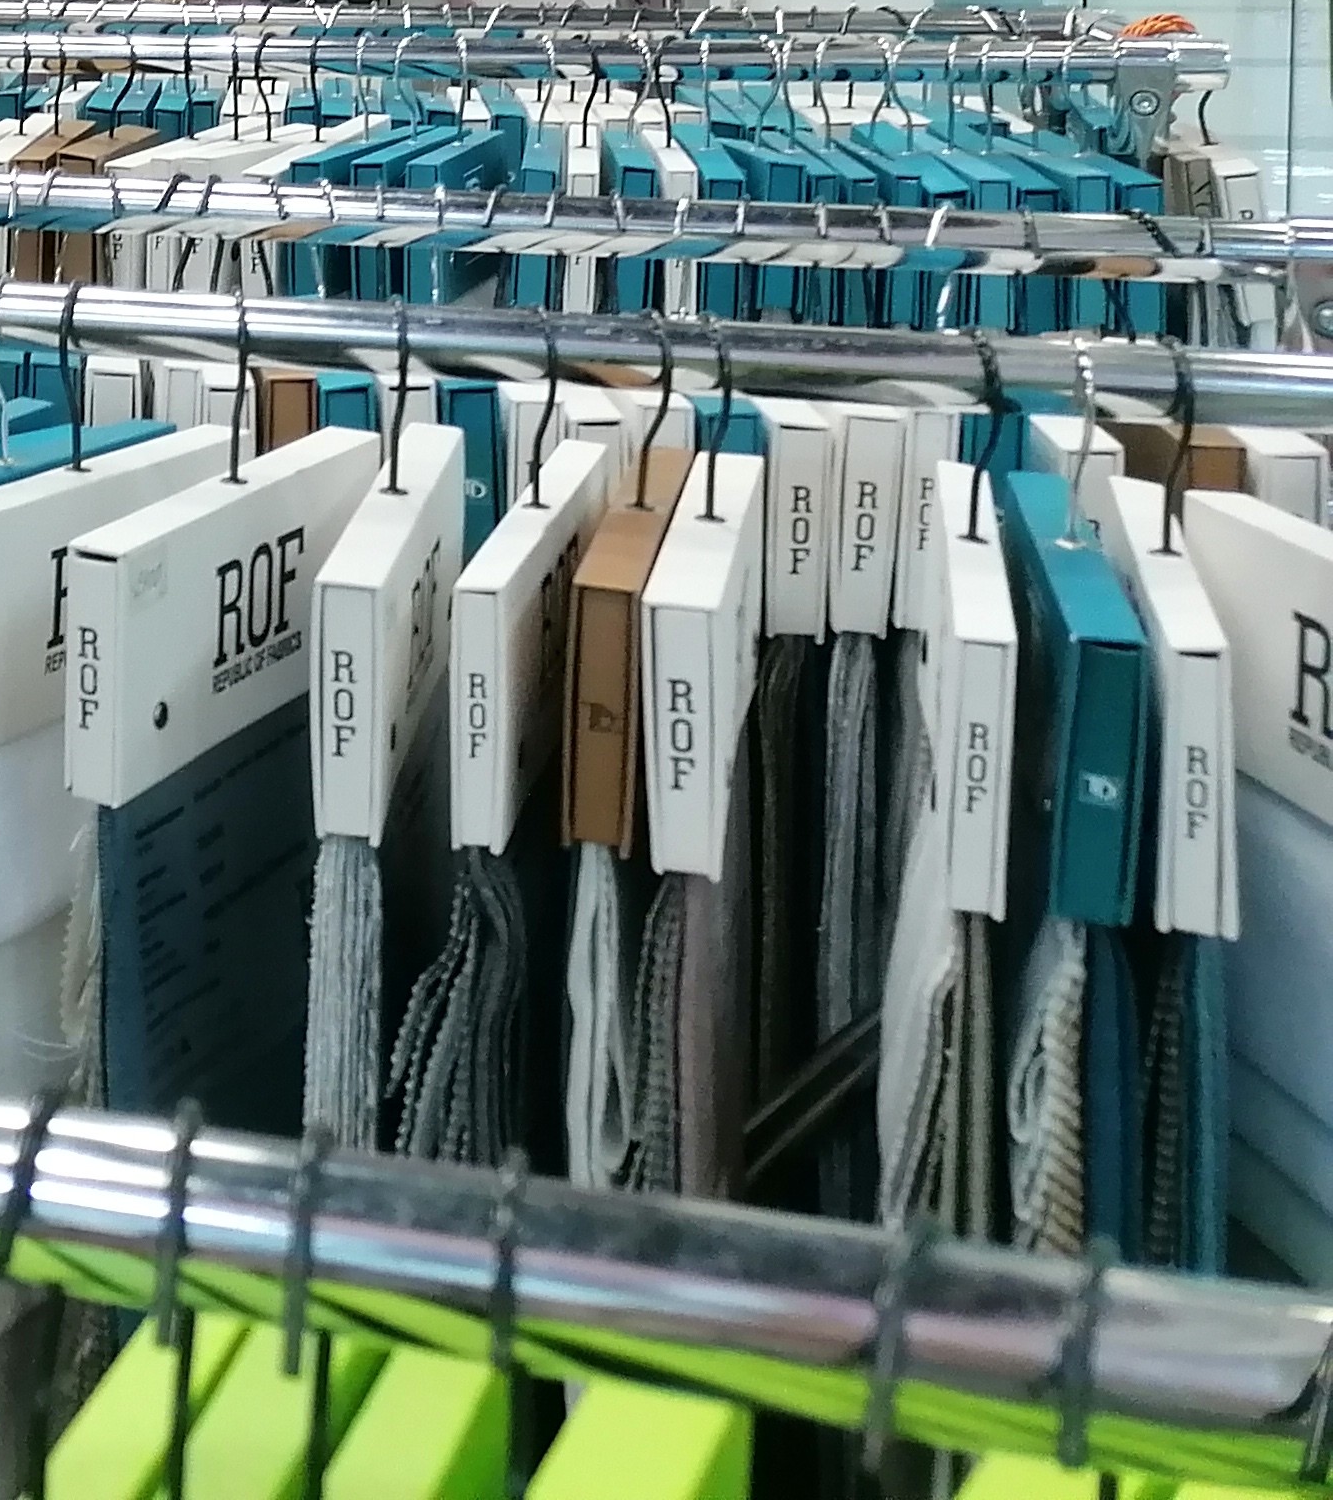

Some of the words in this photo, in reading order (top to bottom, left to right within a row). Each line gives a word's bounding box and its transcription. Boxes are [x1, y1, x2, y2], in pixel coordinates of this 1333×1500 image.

[790, 485, 812, 575] ROF
[850, 481, 877, 572] ROF
[213, 526, 305, 669] ROF
[78, 626, 99, 729] ROF
[331, 650, 356, 757] ROF
[468, 673, 488, 758] ROF
[668, 679, 697, 790] ROF
[966, 722, 988, 813] ROF
[1186, 745, 1208, 839] ROF
